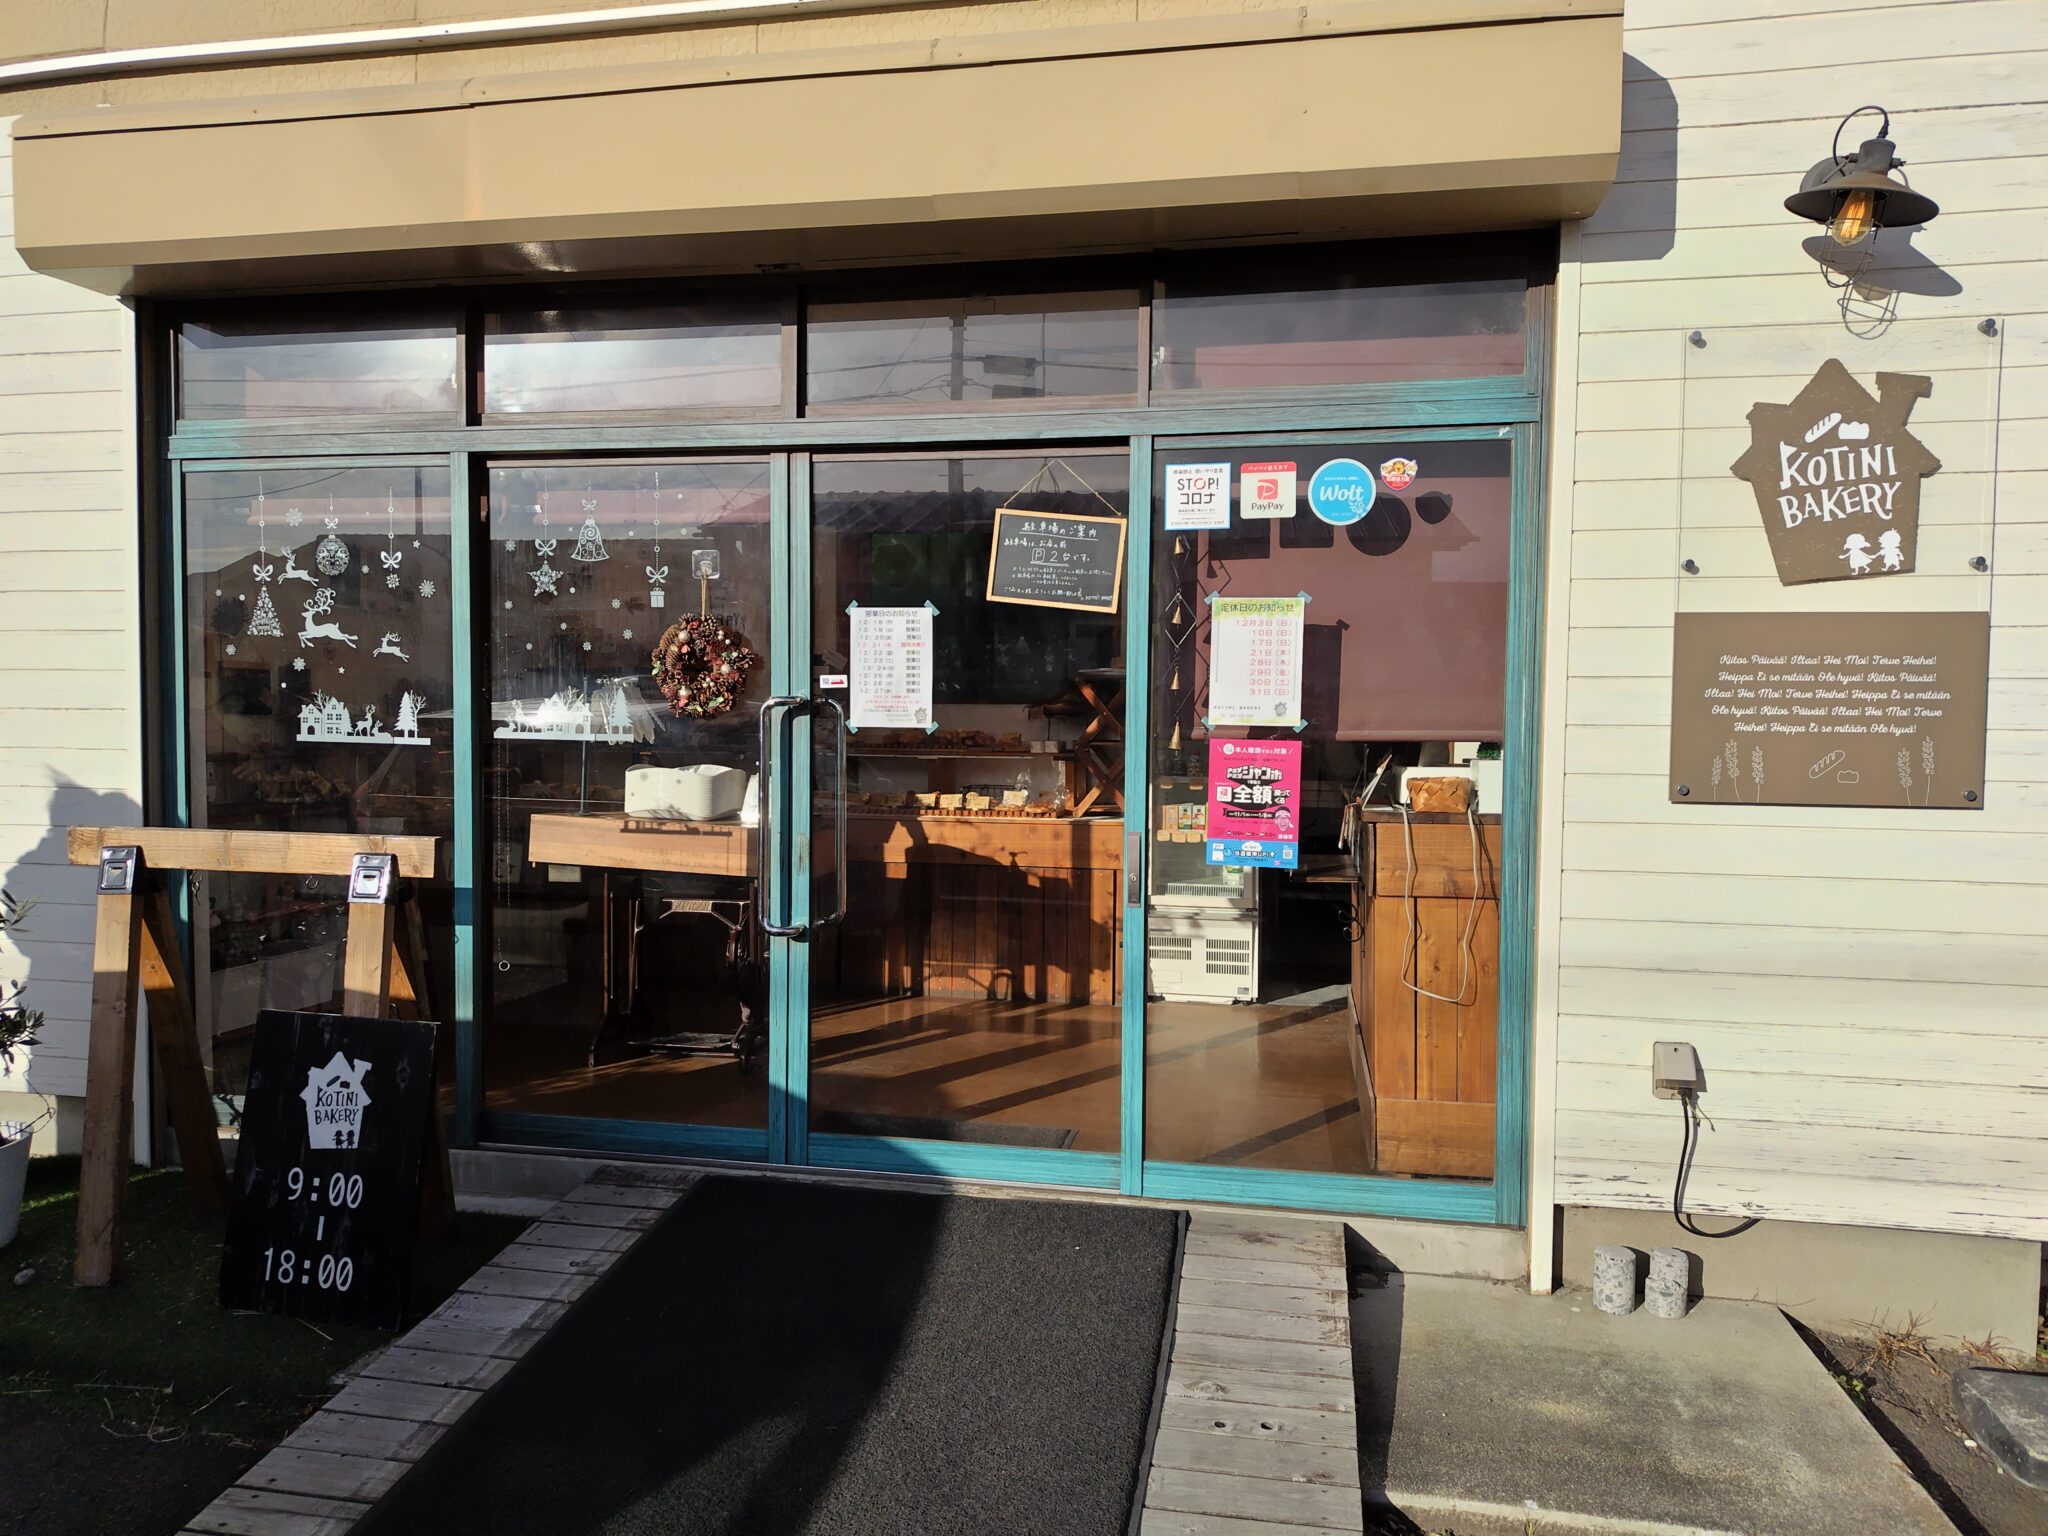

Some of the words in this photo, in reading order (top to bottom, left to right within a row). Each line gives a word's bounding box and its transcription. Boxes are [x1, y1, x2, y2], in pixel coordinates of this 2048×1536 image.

[1779, 441, 1898, 490] KOTINI
[1177, 477, 1219, 491] STOP!
[1180, 492, 1216, 505] コロナ
[1320, 484, 1365, 501] Wolt
[1251, 502, 1284, 511] PayPay
[1777, 482, 1902, 528] BAKERY
[1021, 521, 1097, 539] 駐車場のご案内
[1220, 603, 1295, 612] 定休日のお知らせ
[1751, 655, 1787, 665] Päivää!
[1790, 655, 1821, 665] Iltaa!
[1823, 655, 1841, 665] Hei
[1844, 655, 1869, 665] Moi!
[1872, 655, 1900, 665] Terve
[1902, 656, 1937, 665] Heihei!
[1718, 671, 1754, 683] Heippa
[1756, 672, 1767, 682] Ei
[1782, 672, 1815, 682] mitään
[1817, 672, 1836, 682] Ole
[1836, 672, 1864, 684] hyvä!
[1899, 673, 1937, 682] Päivää!
[1704, 688, 1735, 698] Iltaa!
[1737, 688, 1755, 698] Hei
[1758, 689, 1783, 699] Moi!
[1785, 689, 1813, 699] Terve
[1815, 689, 1849, 699] Heihei!
[1851, 689, 1888, 701] Heippa
[1890, 689, 1901, 699] Ei
[1916, 690, 1951, 700] mitään
[1711, 705, 1730, 715] Ole
[1730, 705, 1757, 717] hyvä!
[1791, 706, 1828, 716] Päivää!
[1831, 706, 1862, 716] Iltaa!
[1864, 706, 1883, 716] Hei
[1885, 706, 1911, 716] Moi!
[1913, 707, 1943, 717] Terve
[1734, 722, 1767, 732] Heihei!
[1770, 723, 1806, 735] Heippa
[1808, 723, 1819, 733] Ei
[1833, 723, 1867, 733] mitään
[1870, 723, 1888, 733] Ole
[1889, 723, 1917, 735] hyvä!
[1233, 784, 1273, 804] 全額
[315, 1085, 359, 1107] KOTINI
[314, 1107, 359, 1126] BAKERY
[287, 1167, 363, 1209] 9:00
[264, 1247, 353, 1292] 18:00
